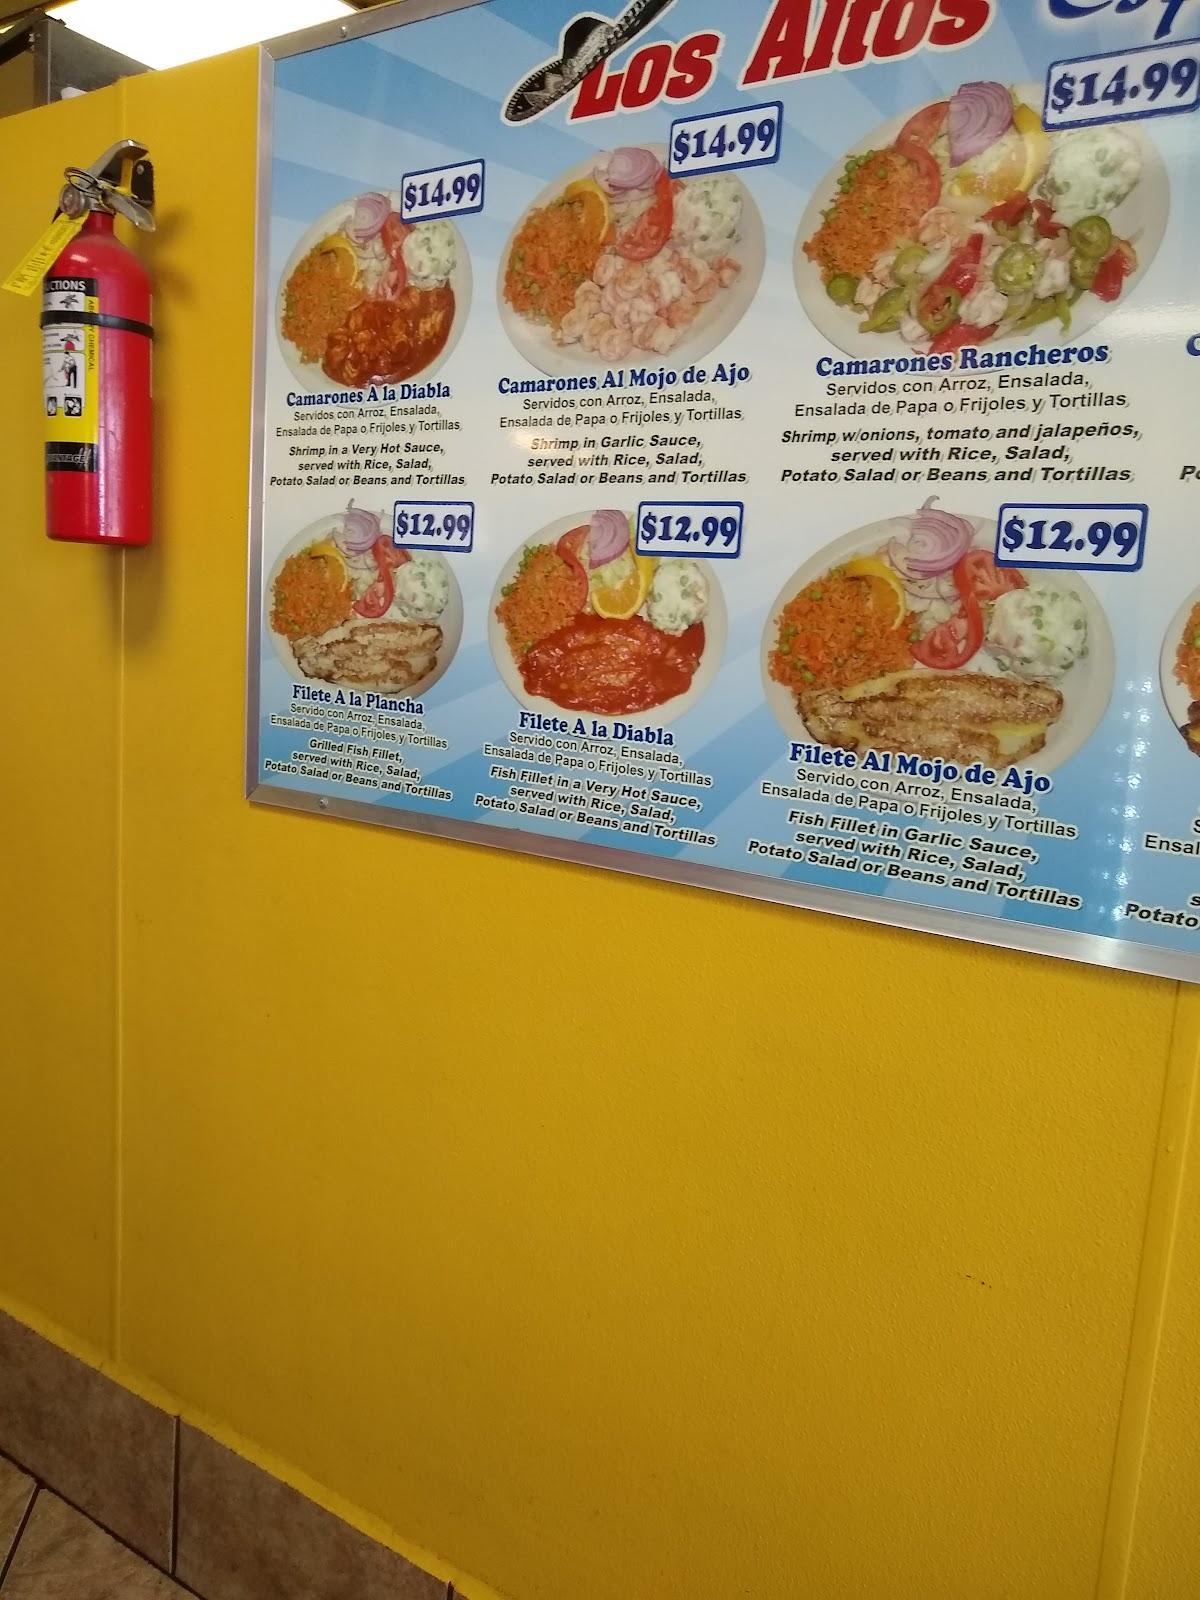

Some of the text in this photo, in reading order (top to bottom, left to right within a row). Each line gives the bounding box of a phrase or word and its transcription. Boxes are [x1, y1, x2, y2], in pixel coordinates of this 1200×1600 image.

[1052, 57, 1197, 114] $14.99
[673, 119, 775, 164] $14.99
[405, 174, 479, 212] $14.99
[816, 346, 1108, 377] Camarones Rancheros
[498, 364, 749, 394] Camarones Al Mojo de Ajo
[827, 374, 1089, 396] Servidos con Arroz, Ensalada,
[287, 384, 450, 407] Camarones A la Diabla
[523, 391, 715, 410] Servidos con Arroz, Ensalada,
[795, 393, 1127, 417] Ensalada de Papa o Frijoles y Tortillas
[294, 405, 440, 421] Servidos con Arroz, Ensalada,
[289, 443, 444, 458] Shrimp in a Very Hot Sauce,
[530, 435, 701, 452] Shrimp in Garlic Sauce,
[781, 430, 836, 445] Shrimp
[927, 428, 990, 440] tomato
[995, 426, 1031, 439] and
[831, 447, 1069, 463] served with Rice, Salad,
[270, 477, 303, 486] Potato
[306, 476, 335, 485] Salad
[353, 476, 387, 485] Beans
[391, 475, 412, 485] and
[415, 475, 465, 485] Tortillas
[781, 467, 1131, 482] Potato Salad or Beans and Tortillas
[397, 510, 470, 541] $12.99
[641, 511, 737, 547] $12.99
[1002, 516, 1137, 557] $12.99
[292, 685, 424, 714] Filete A la Plancha
[290, 704, 425, 731] Servido con Arroz, Ensalada,
[519, 712, 674, 746] Filete A la Diabla
[309, 739, 403, 763] Grilled Fish Fillet,
[484, 744, 712, 786] Ensalada de Papa o Frijoles y Tortillas
[509, 732, 683, 767] Servido con Arroz, Ensalada,
[789, 743, 1050, 795] Filete Al Mojo de Ajo
[490, 767, 701, 811] Fish Fillet in a Very Hot Sauce,
[796, 769, 1036, 814] Servido con Arroz, Ensalada,
[475, 795, 716, 845] Potato Salad or Beans and Tortillas
[510, 788, 674, 825] served with Rice, Salad,
[761, 783, 1077, 838] Ensalada de Papa o Frijoles y Tortillas
[788, 811, 1037, 862] Fish Fillet in Garlic Sauce,
[795, 833, 1024, 880] served with Rice, Salad,
[748, 841, 1080, 908] Potato Salad or Beans and Tortillas
[1125, 903, 1198, 927] Potato
